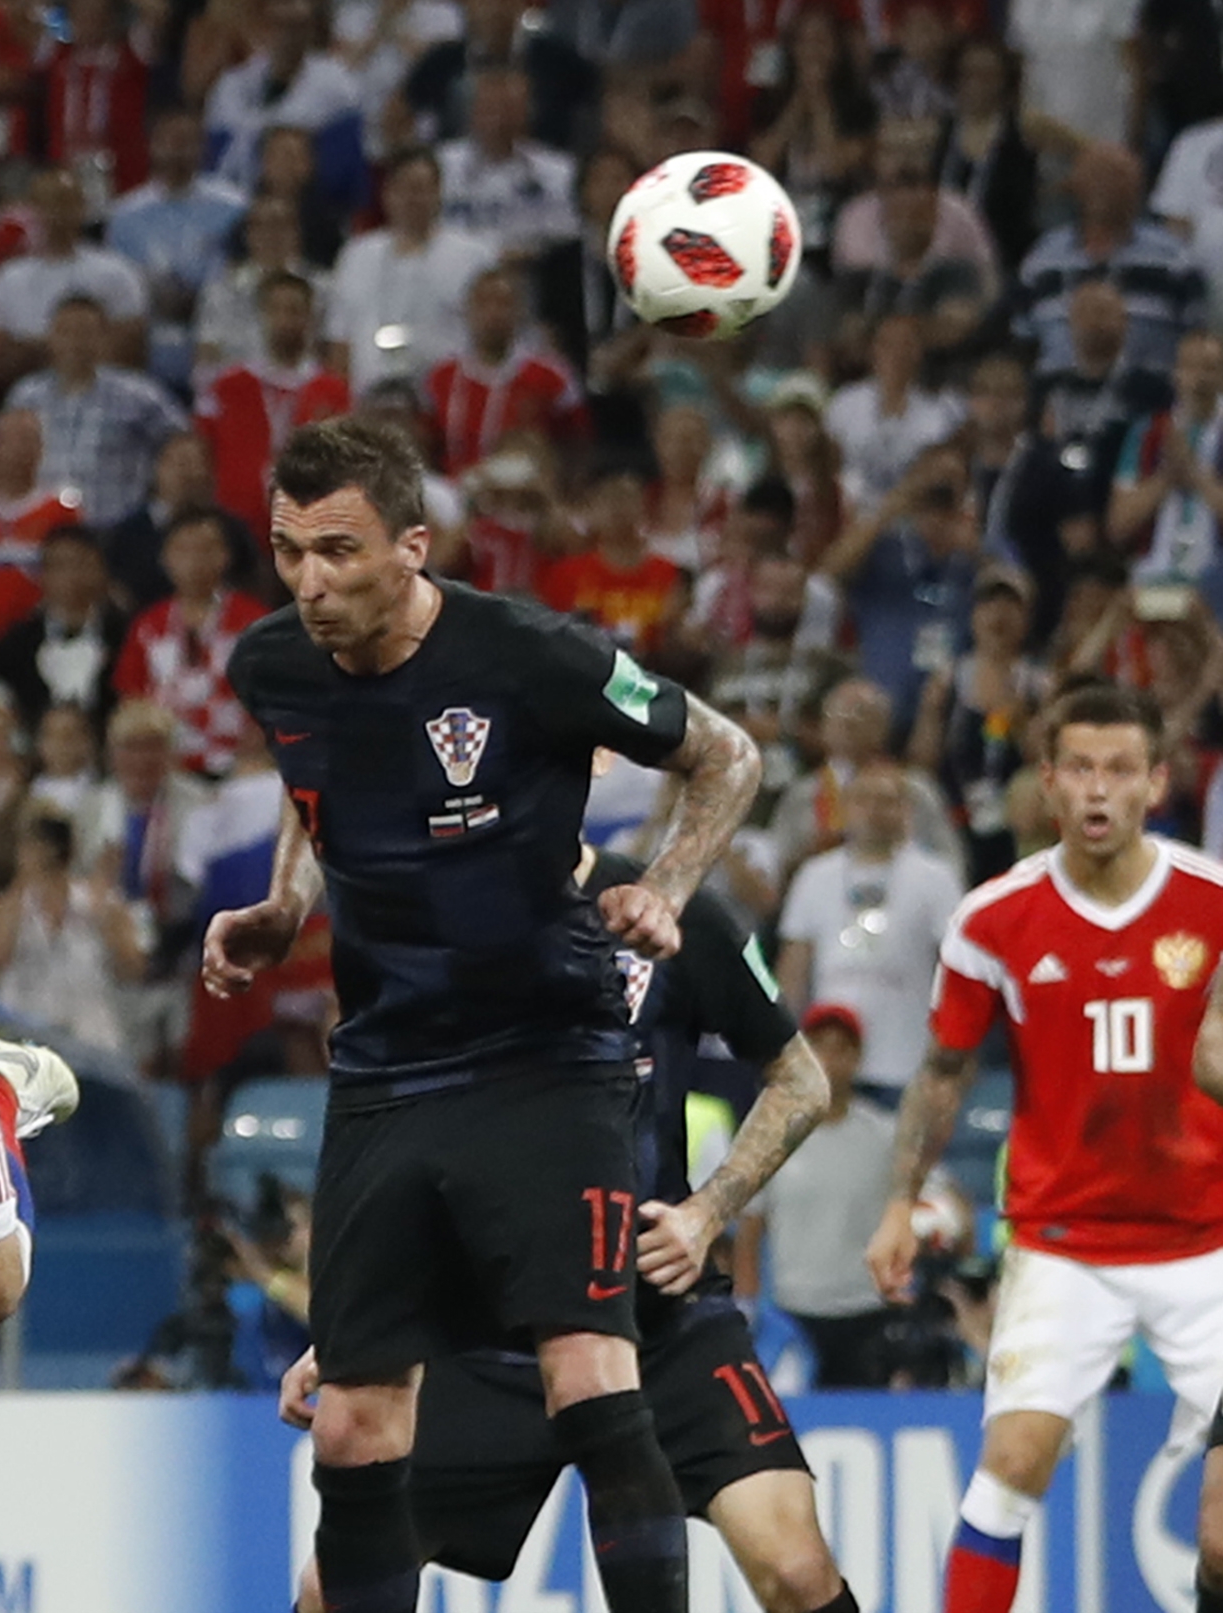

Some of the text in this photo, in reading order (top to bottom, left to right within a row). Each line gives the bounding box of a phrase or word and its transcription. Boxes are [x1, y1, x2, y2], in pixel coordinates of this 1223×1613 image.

[1083, 997, 1154, 1074] 10
[581, 1187, 635, 1272] 17
[712, 1361, 786, 1425] 11
